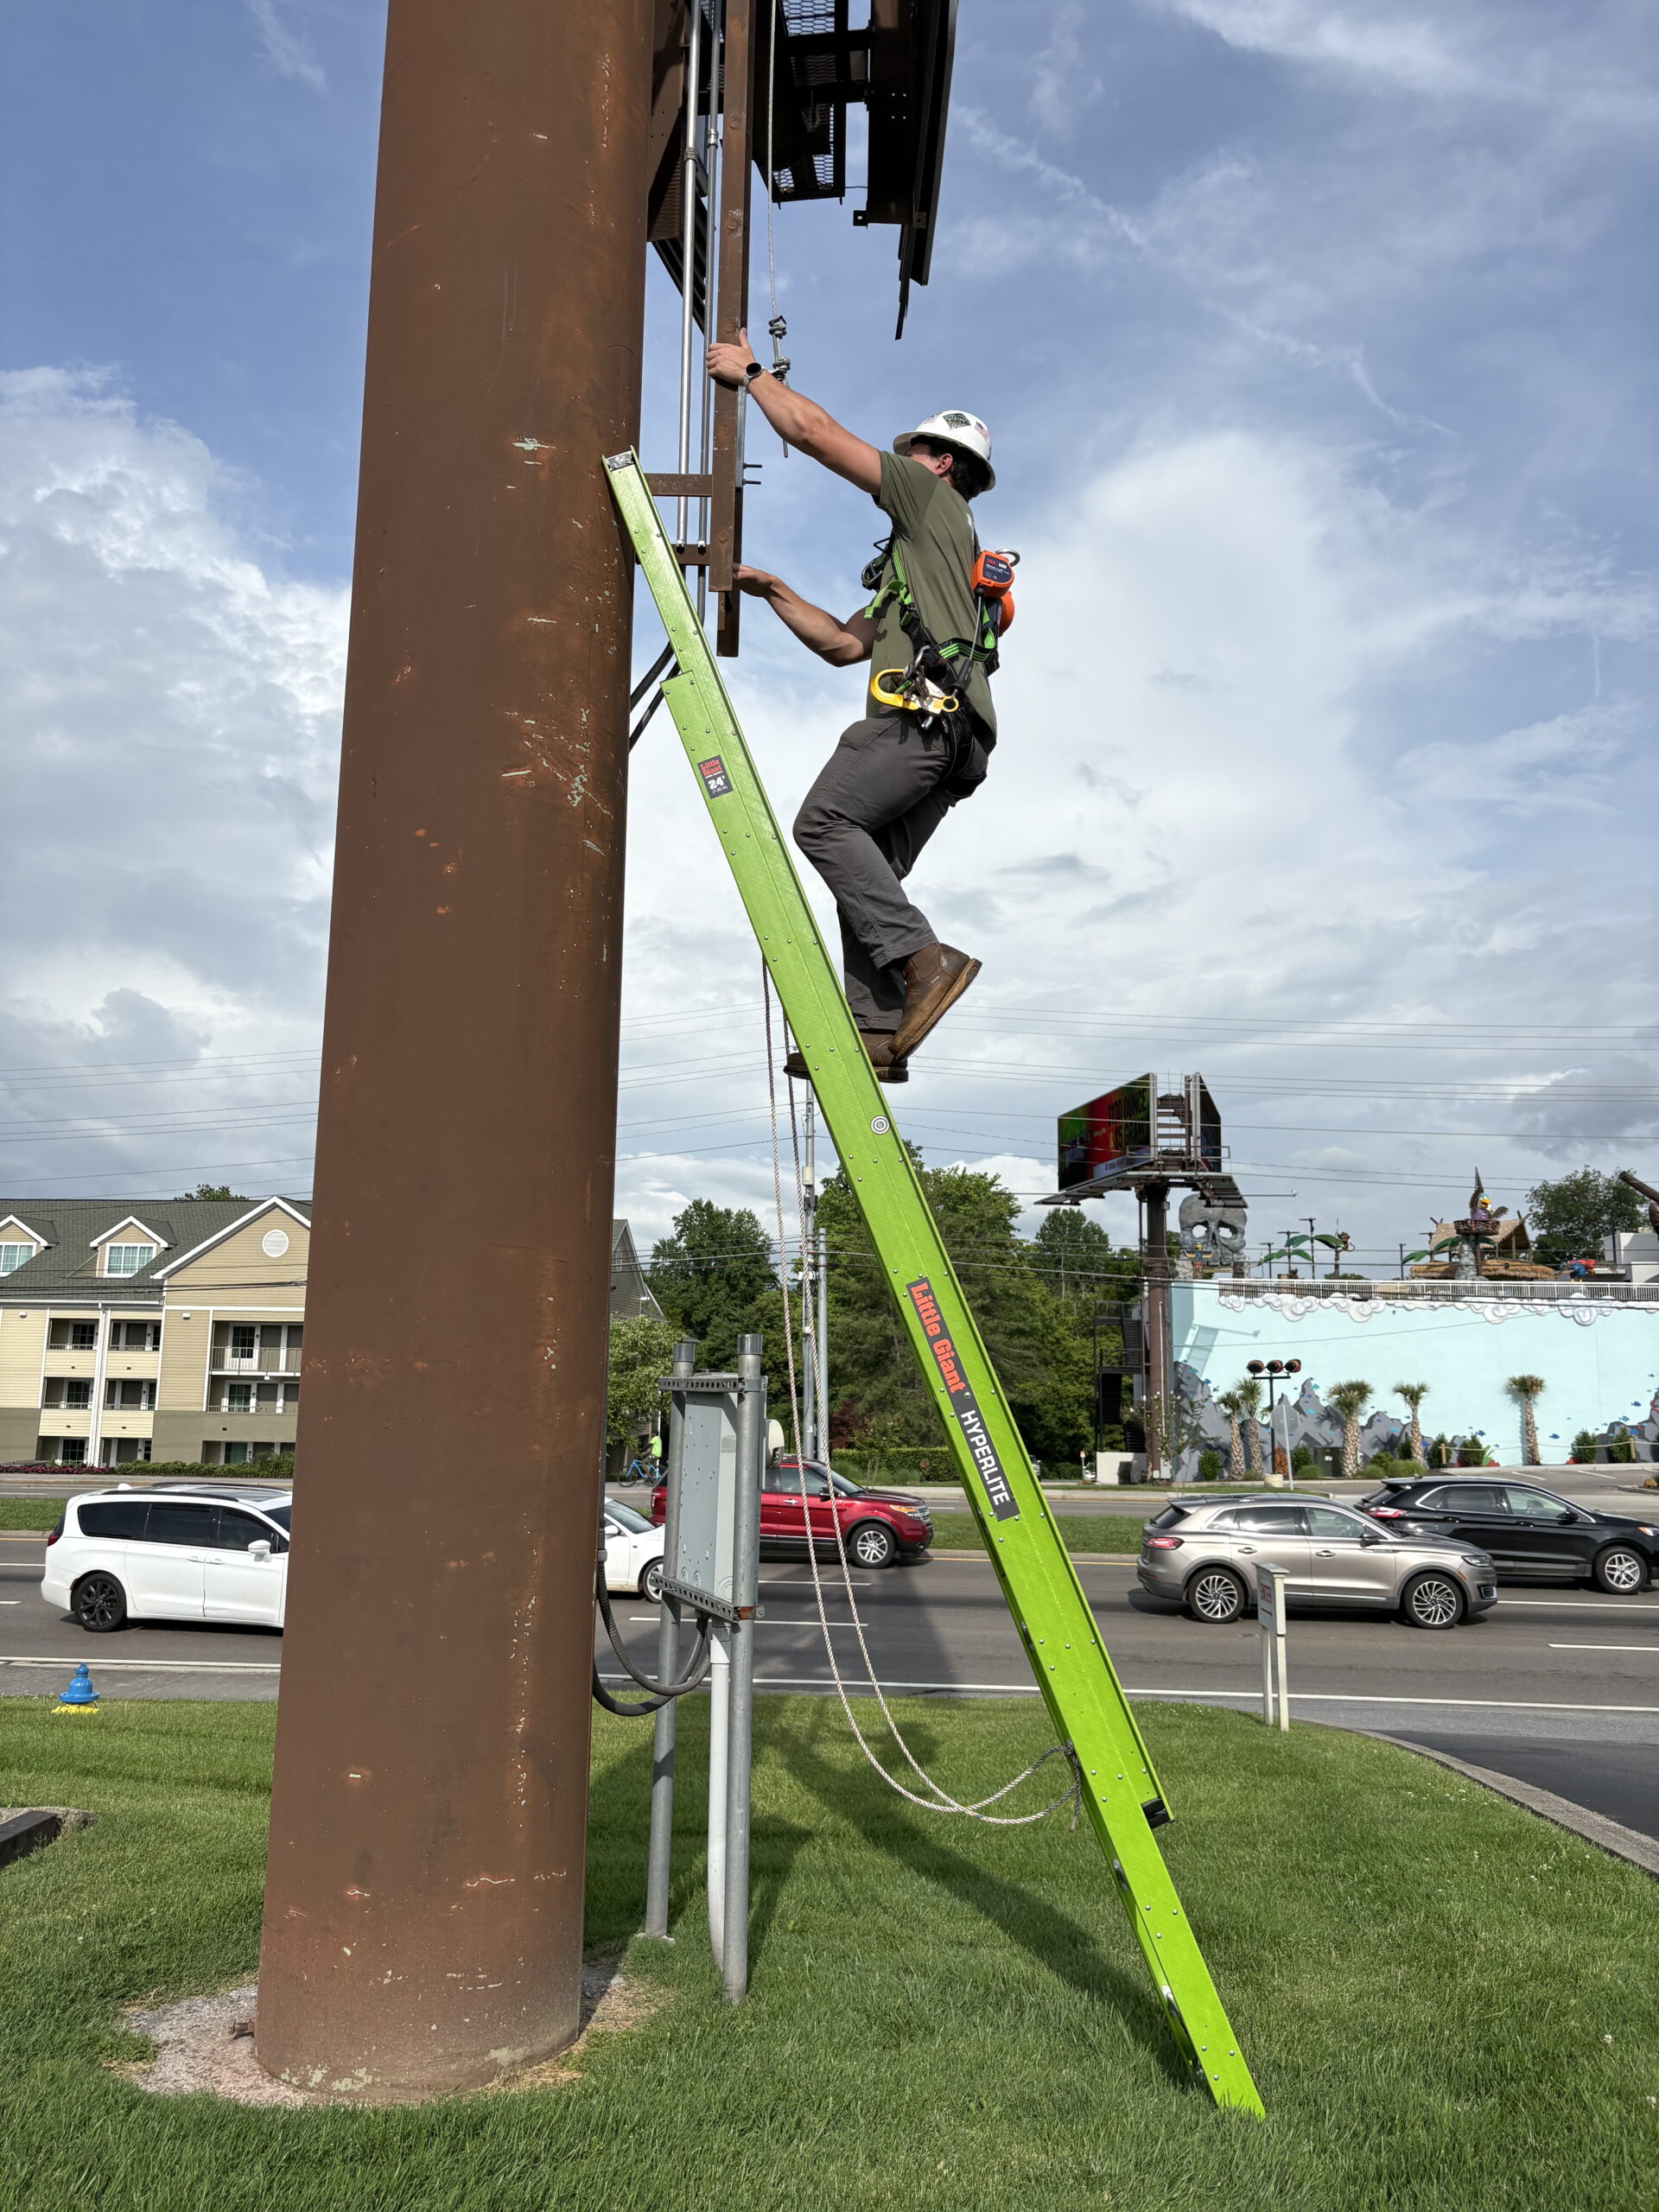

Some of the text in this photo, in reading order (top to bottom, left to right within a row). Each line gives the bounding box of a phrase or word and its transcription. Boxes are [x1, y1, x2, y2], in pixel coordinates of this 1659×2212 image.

[701, 760, 719, 770] Little
[702, 765, 721, 776] Giant
[1123, 1089, 1147, 1119] OUNCE
[910, 1281, 966, 1394] Little Giant
[960, 1409, 1011, 1506] HYPERLITE
